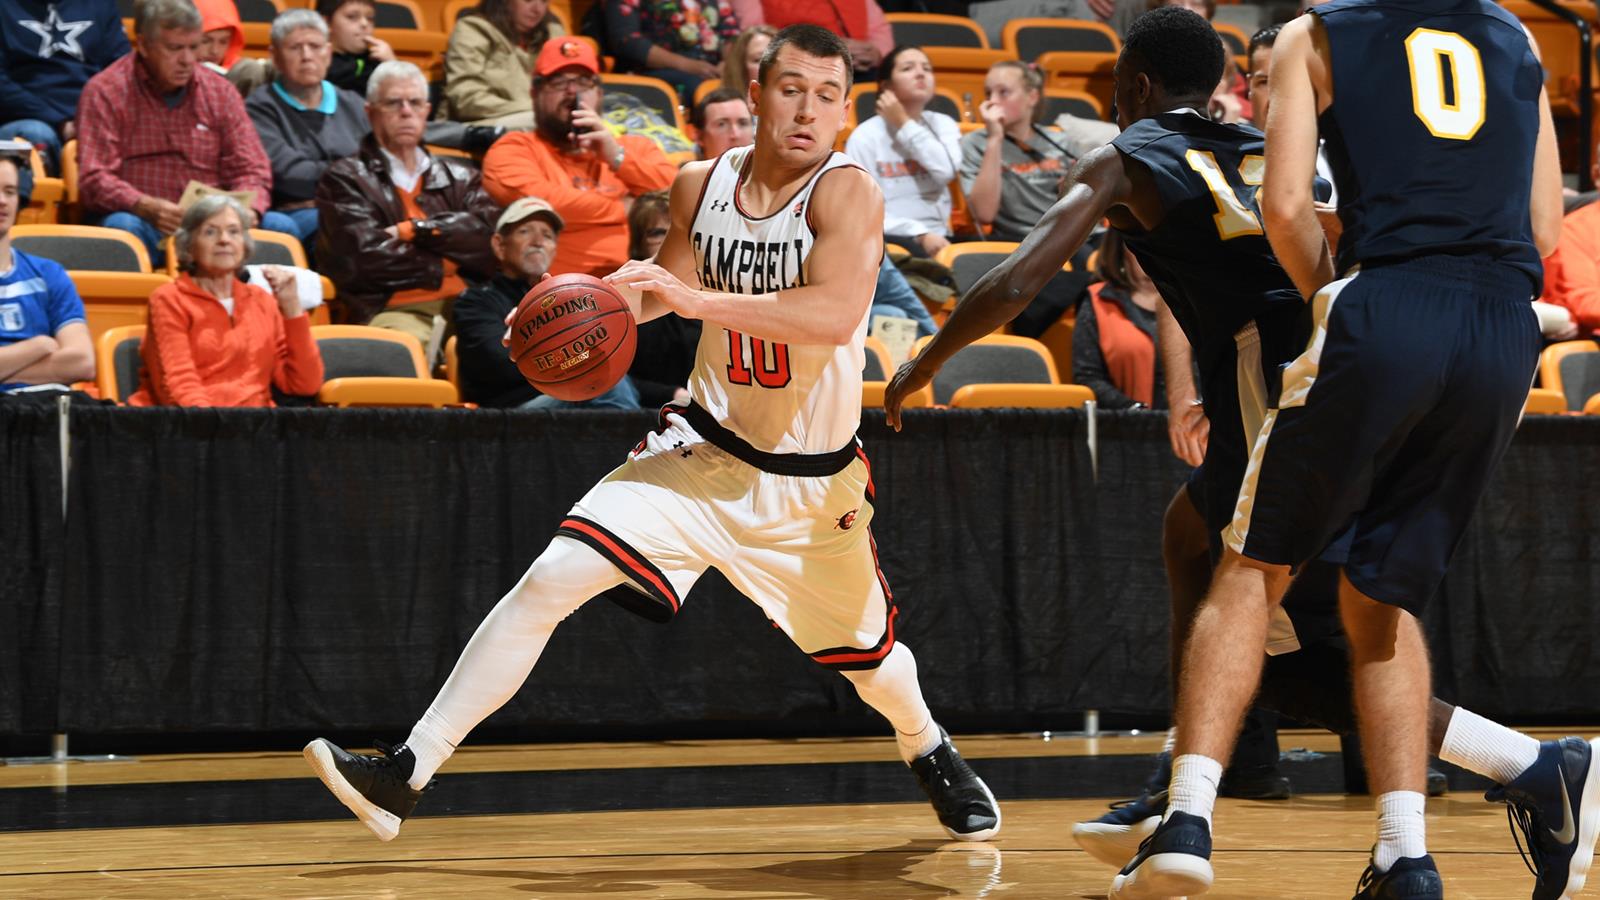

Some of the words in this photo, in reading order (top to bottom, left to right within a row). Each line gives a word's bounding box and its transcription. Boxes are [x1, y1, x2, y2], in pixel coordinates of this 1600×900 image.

[1404, 27, 1487, 140] 0
[520, 294, 598, 344] SPALDING
[560, 350, 591, 370] LEGACY
[723, 328, 792, 388] 10
